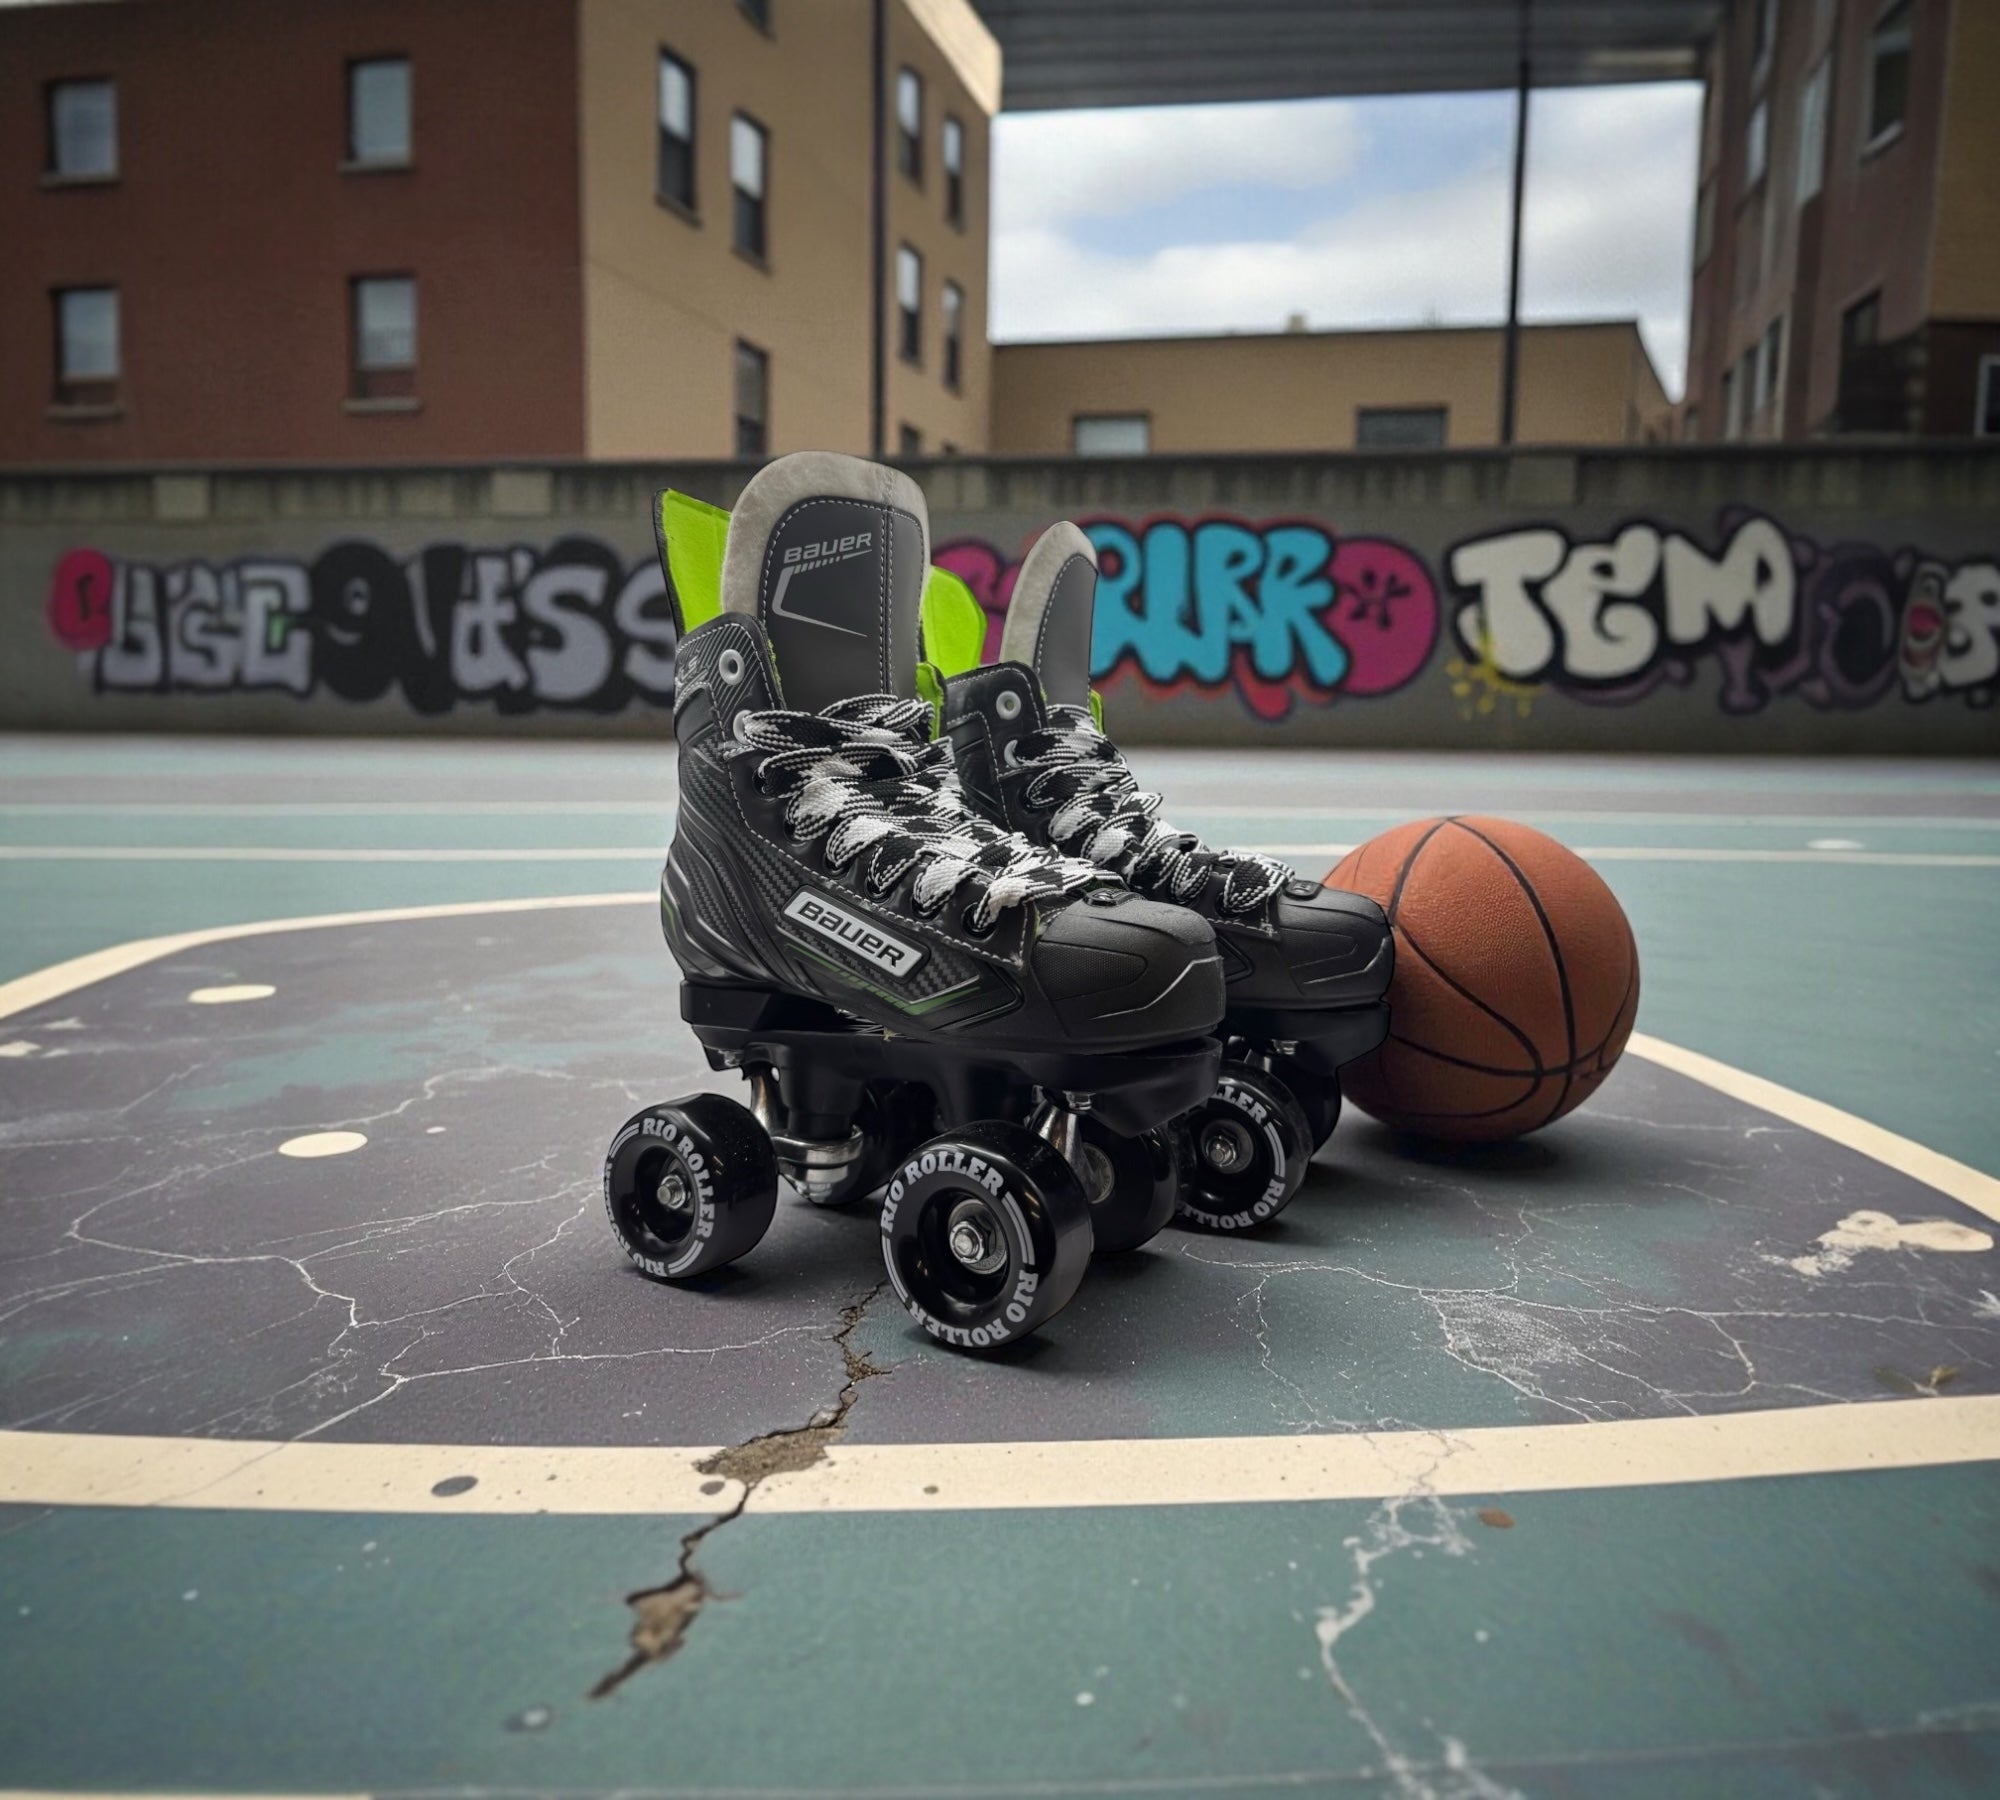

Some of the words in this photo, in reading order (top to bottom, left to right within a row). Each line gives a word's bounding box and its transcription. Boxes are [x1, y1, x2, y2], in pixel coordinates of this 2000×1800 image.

[783, 532, 872, 564] BAUER
[798, 901, 905, 968] BAUER
[642, 1117, 678, 1142] RIO
[677, 1135, 716, 1239] ROLLER
[881, 1179, 905, 1233] RIO
[904, 1151, 1004, 1197] ROLLER
[1253, 1178, 1286, 1217] RIO
[1175, 1201, 1254, 1230] ROLLE
[632, 1252, 668, 1277] RIO
[1006, 1269, 1039, 1323] RIO
[910, 1300, 1012, 1347] ROLLER
